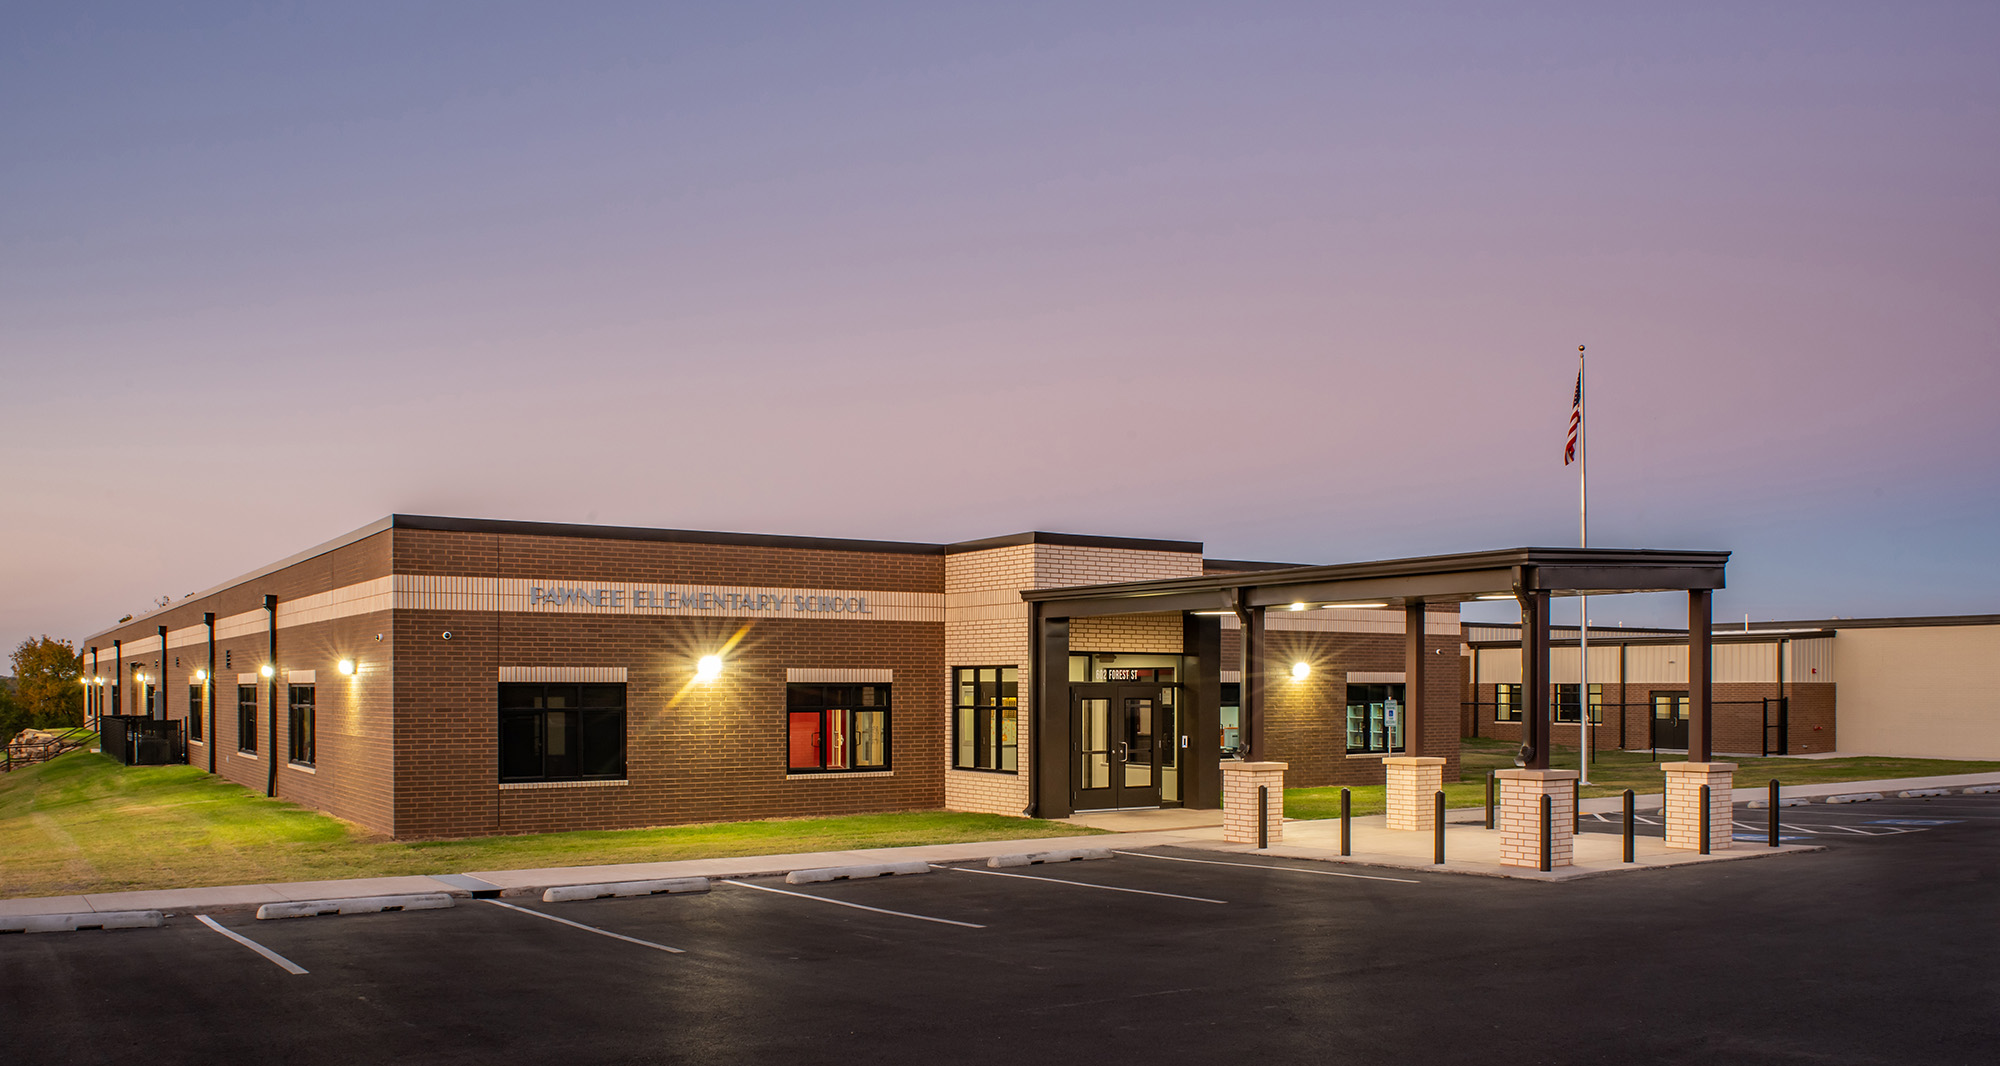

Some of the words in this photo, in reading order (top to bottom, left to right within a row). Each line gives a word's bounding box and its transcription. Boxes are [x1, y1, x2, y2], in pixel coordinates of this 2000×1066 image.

[530, 586, 625, 608] PAWNEE
[633, 589, 787, 612] ELEMENTARY
[793, 594, 873, 614] SCHOOL
[1108, 669, 1130, 680] FOREST
[1130, 669, 1138, 680] ST
